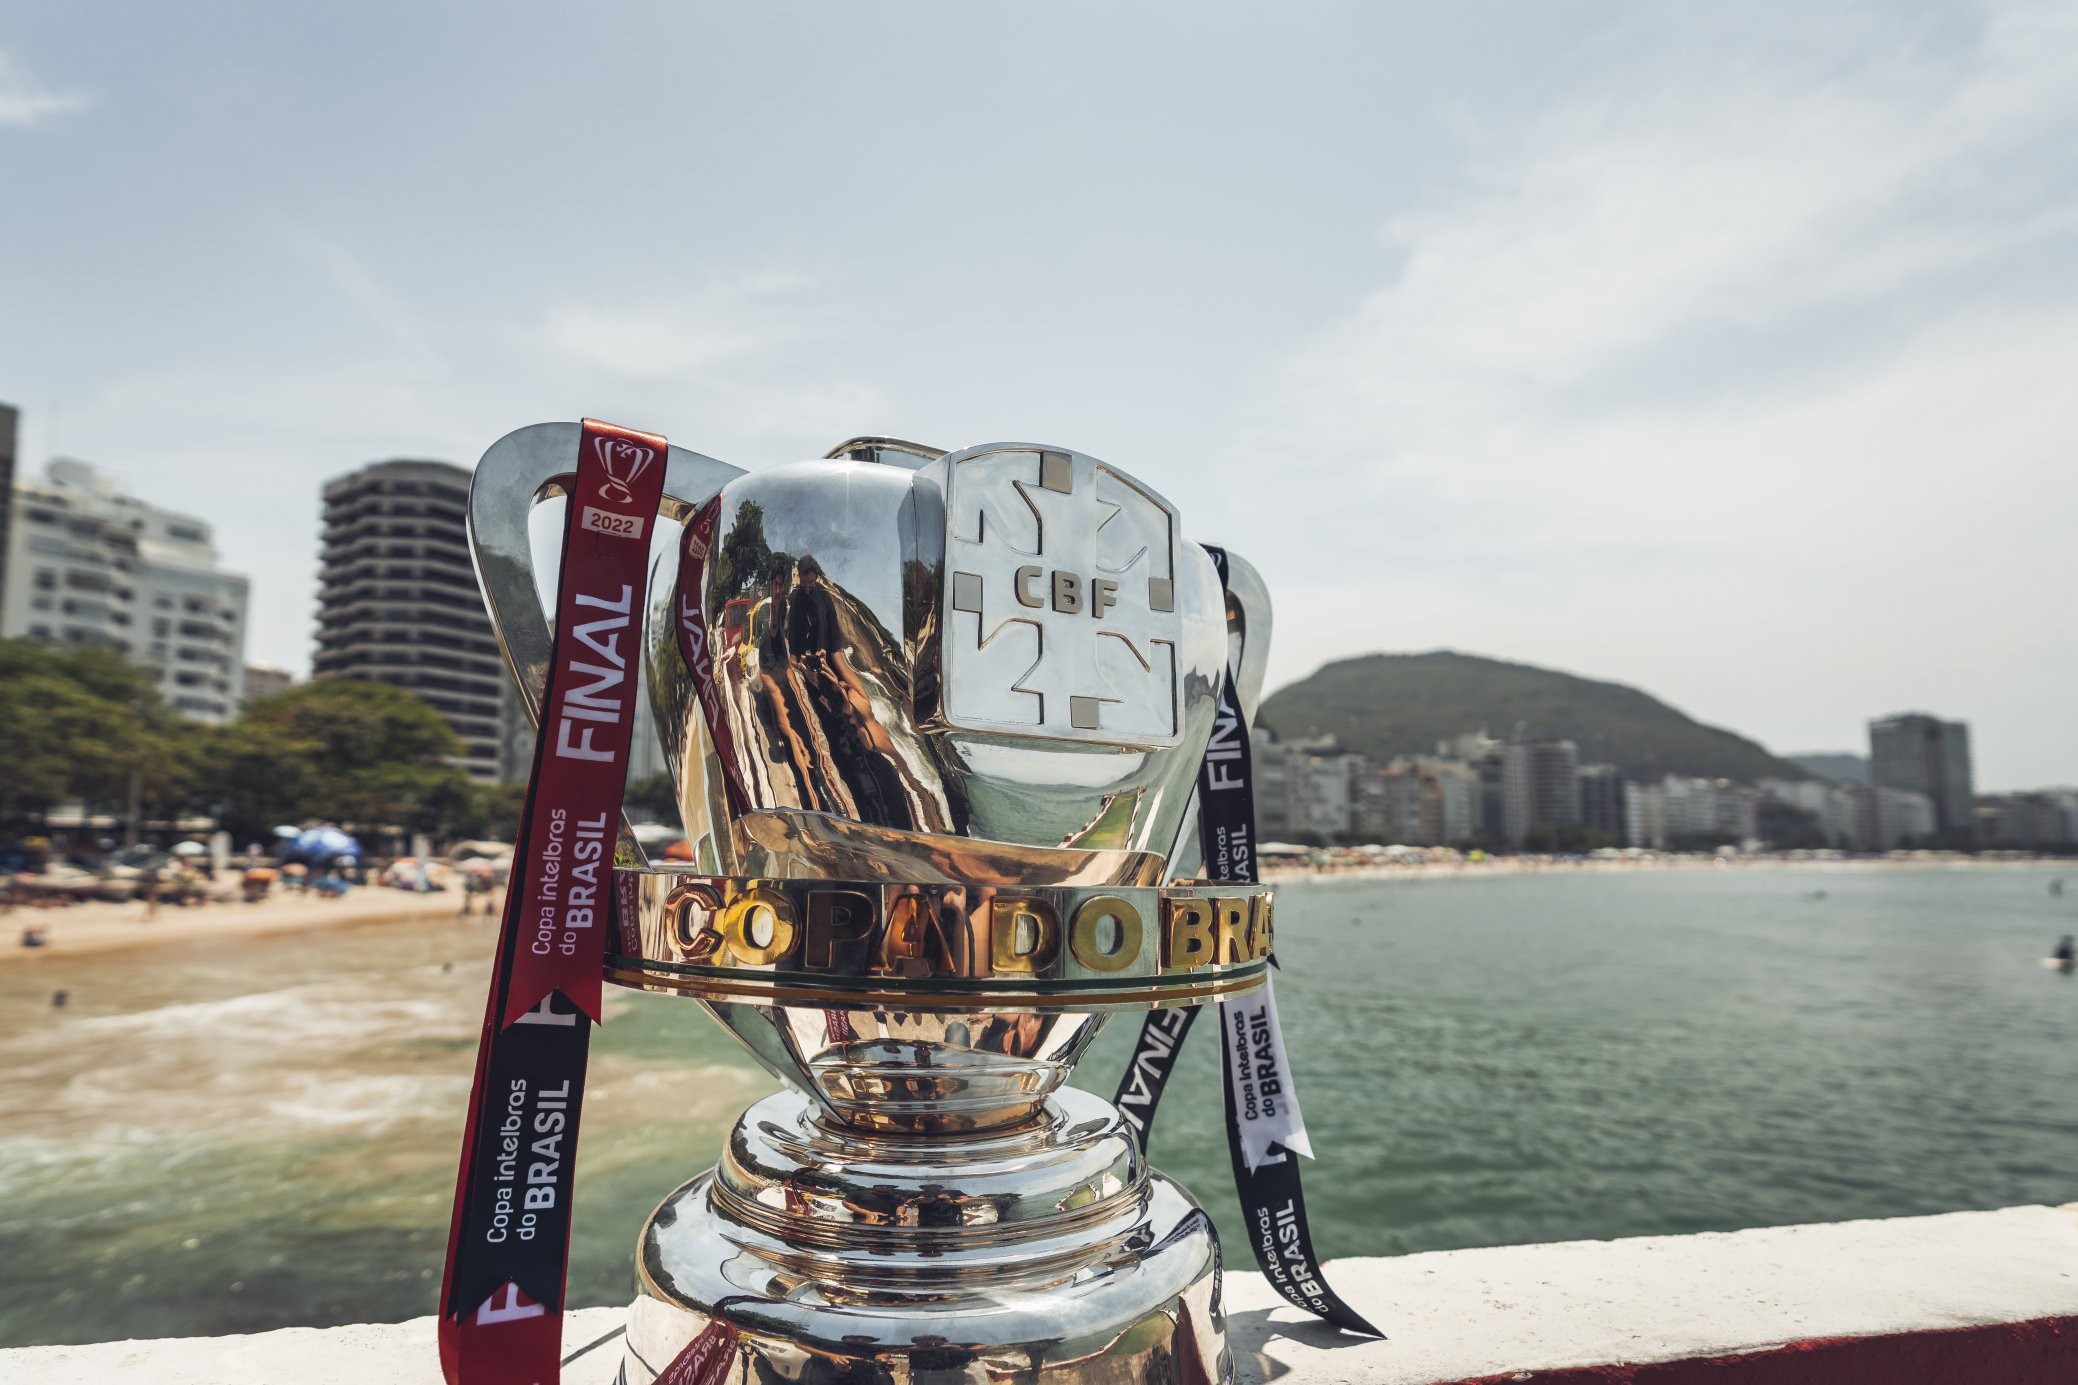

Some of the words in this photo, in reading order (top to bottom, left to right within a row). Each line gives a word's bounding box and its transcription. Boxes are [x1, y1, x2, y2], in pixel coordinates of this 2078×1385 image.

[591, 513, 633, 534] 2022
[1014, 565, 1119, 619] CBF
[555, 584, 633, 763] FINAL
[537, 808, 566, 900] intelbras
[566, 811, 607, 928] BRASIL
[1231, 824, 1250, 882] ASIL
[532, 906, 557, 955] Copa
[559, 931, 577, 956] do
[665, 882, 956, 979] COPA
[990, 895, 1143, 973] DO
[1250, 1005, 1282, 1096] BRASIL
[493, 1078, 527, 1181] intelbras
[1244, 1083, 1259, 1121] Copa
[1262, 1098, 1276, 1118] do
[523, 1079, 570, 1210] BRASIL
[487, 1187, 513, 1243] Copa
[516, 1213, 537, 1241] do
[1257, 1207, 1288, 1284] intelbras
[1276, 1198, 1324, 1298] BRASIL
[1312, 1297, 1329, 1313] do
